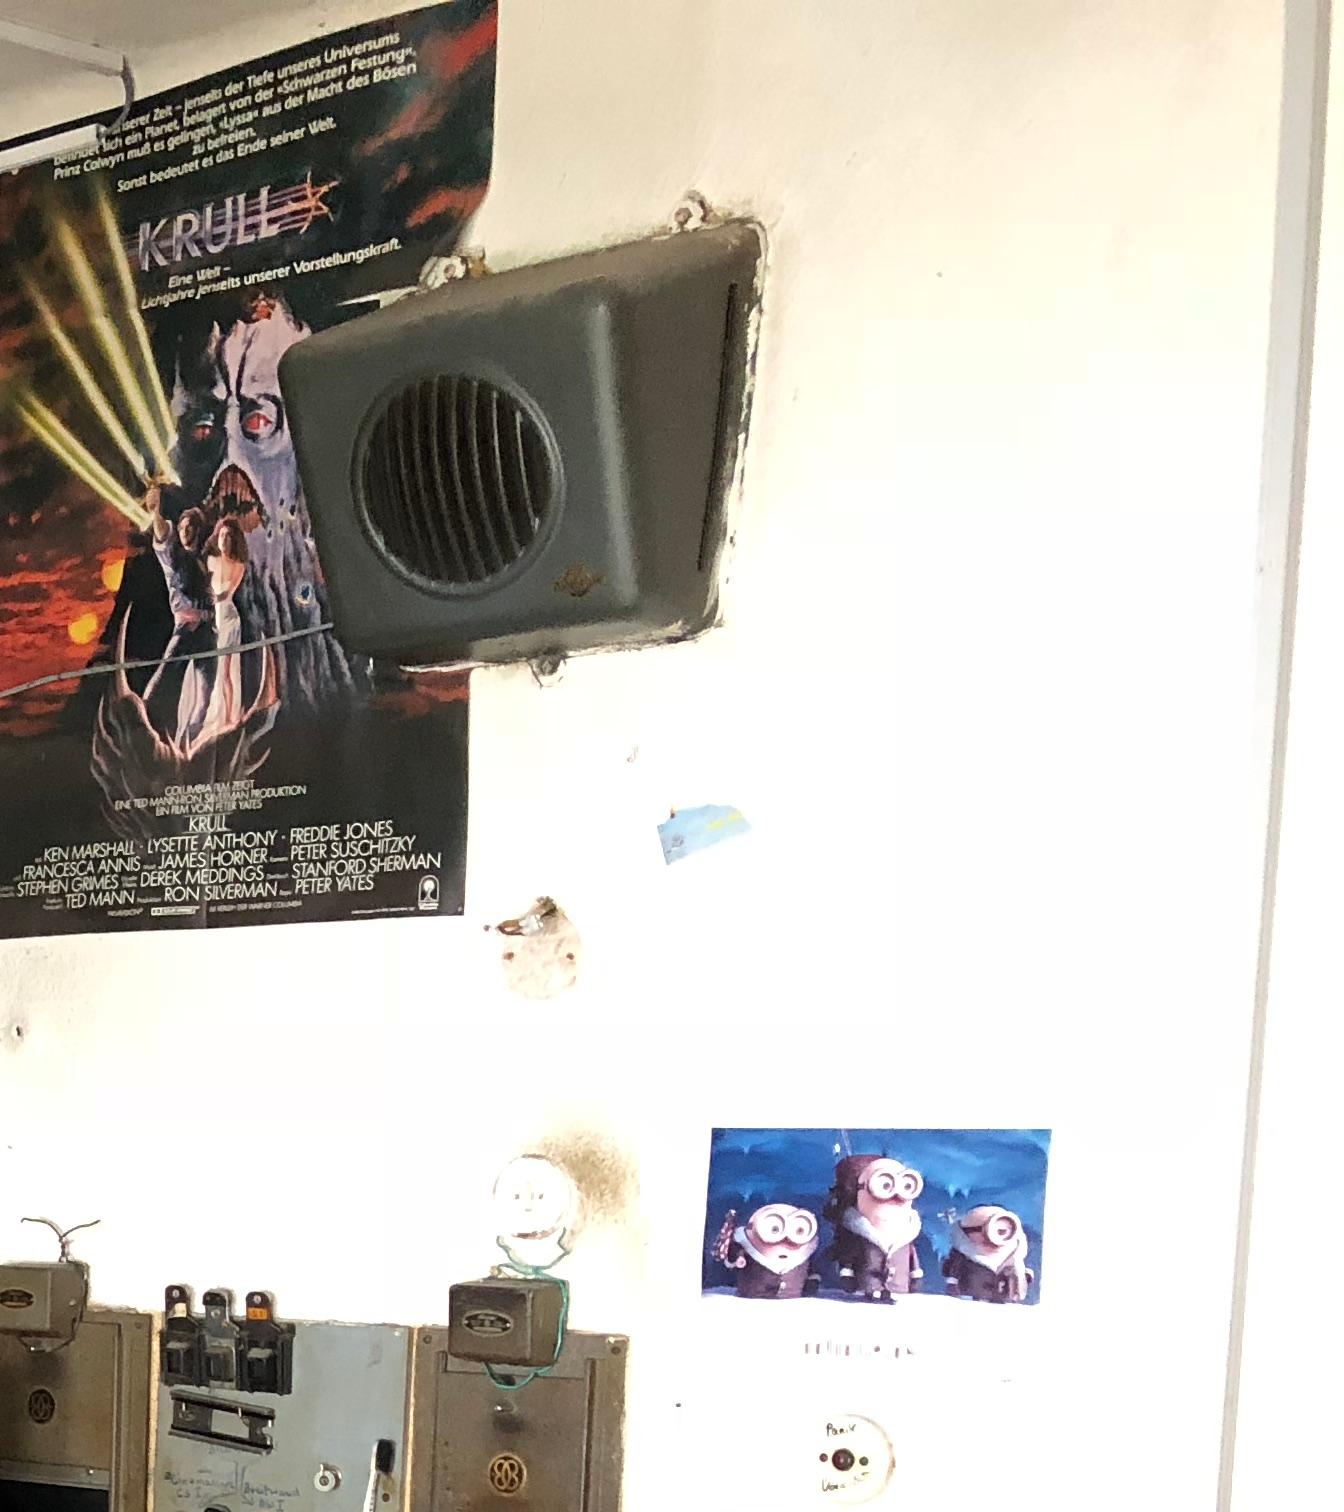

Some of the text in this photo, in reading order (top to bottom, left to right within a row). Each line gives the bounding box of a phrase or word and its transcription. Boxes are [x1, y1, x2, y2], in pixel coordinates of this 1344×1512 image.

[154, 105, 173, 121] Zeit
[184, 88, 222, 114] jenseits
[225, 81, 244, 98] der
[247, 70, 274, 89] Tiefe
[277, 55, 321, 79] unseres
[324, 33, 400, 64] Universums
[54, 165, 81, 181] Prinz
[83, 150, 125, 174] Colwyn
[127, 145, 152, 161] muß
[154, 140, 165, 152] es
[262, 102, 282, 118] aus
[284, 93, 304, 111] der
[307, 80, 343, 102] Macht
[346, 74, 369, 91] des
[373, 62, 417, 84] Bösen
[125, 131, 142, 146] ein
[183, 101, 226, 127] belagert
[229, 95, 251, 112] von
[254, 87, 274, 104] der
[117, 116, 337, 193] Sonst bedeutet es das Ende seiner Welt.
[192, 125, 257, 156] zu befreien.
[138, 185, 280, 272] KRULL
[168, 266, 222, 289] Eine Welt
[195, 275, 241, 301] jenseits
[243, 266, 290, 287] unserer
[292, 236, 401, 274] Vorstellungskraft.
[114, 799, 131, 811] EINE
[133, 797, 148, 809] TED
[203, 789, 250, 803] SILVERMAN
[250, 785, 307, 801] PRODUKTION
[155, 799, 263, 817] EIN FILM VON PETER YATES
[164, 779, 255, 797] COLUMBIA FILM ZEIGT
[43, 820, 394, 864] KEN MARSHALL LYSETTE ANTHONY FREDDIE JONES
[188, 814, 227, 833] KRULL
[16, 879, 69, 898] STEPHEN
[70, 874, 119, 893] GRIMES
[140, 870, 182, 888] DEREK
[185, 865, 265, 886] MEDDINGS
[291, 858, 366, 879] STANFORD
[367, 851, 442, 873] SHERMAN
[23, 834, 416, 881] FRANCESCA ANNIS JAMES HORNER PETER SUSCHITZKY
[65, 873, 374, 910] TED MANN RON SILVERMAN PETER YATES
